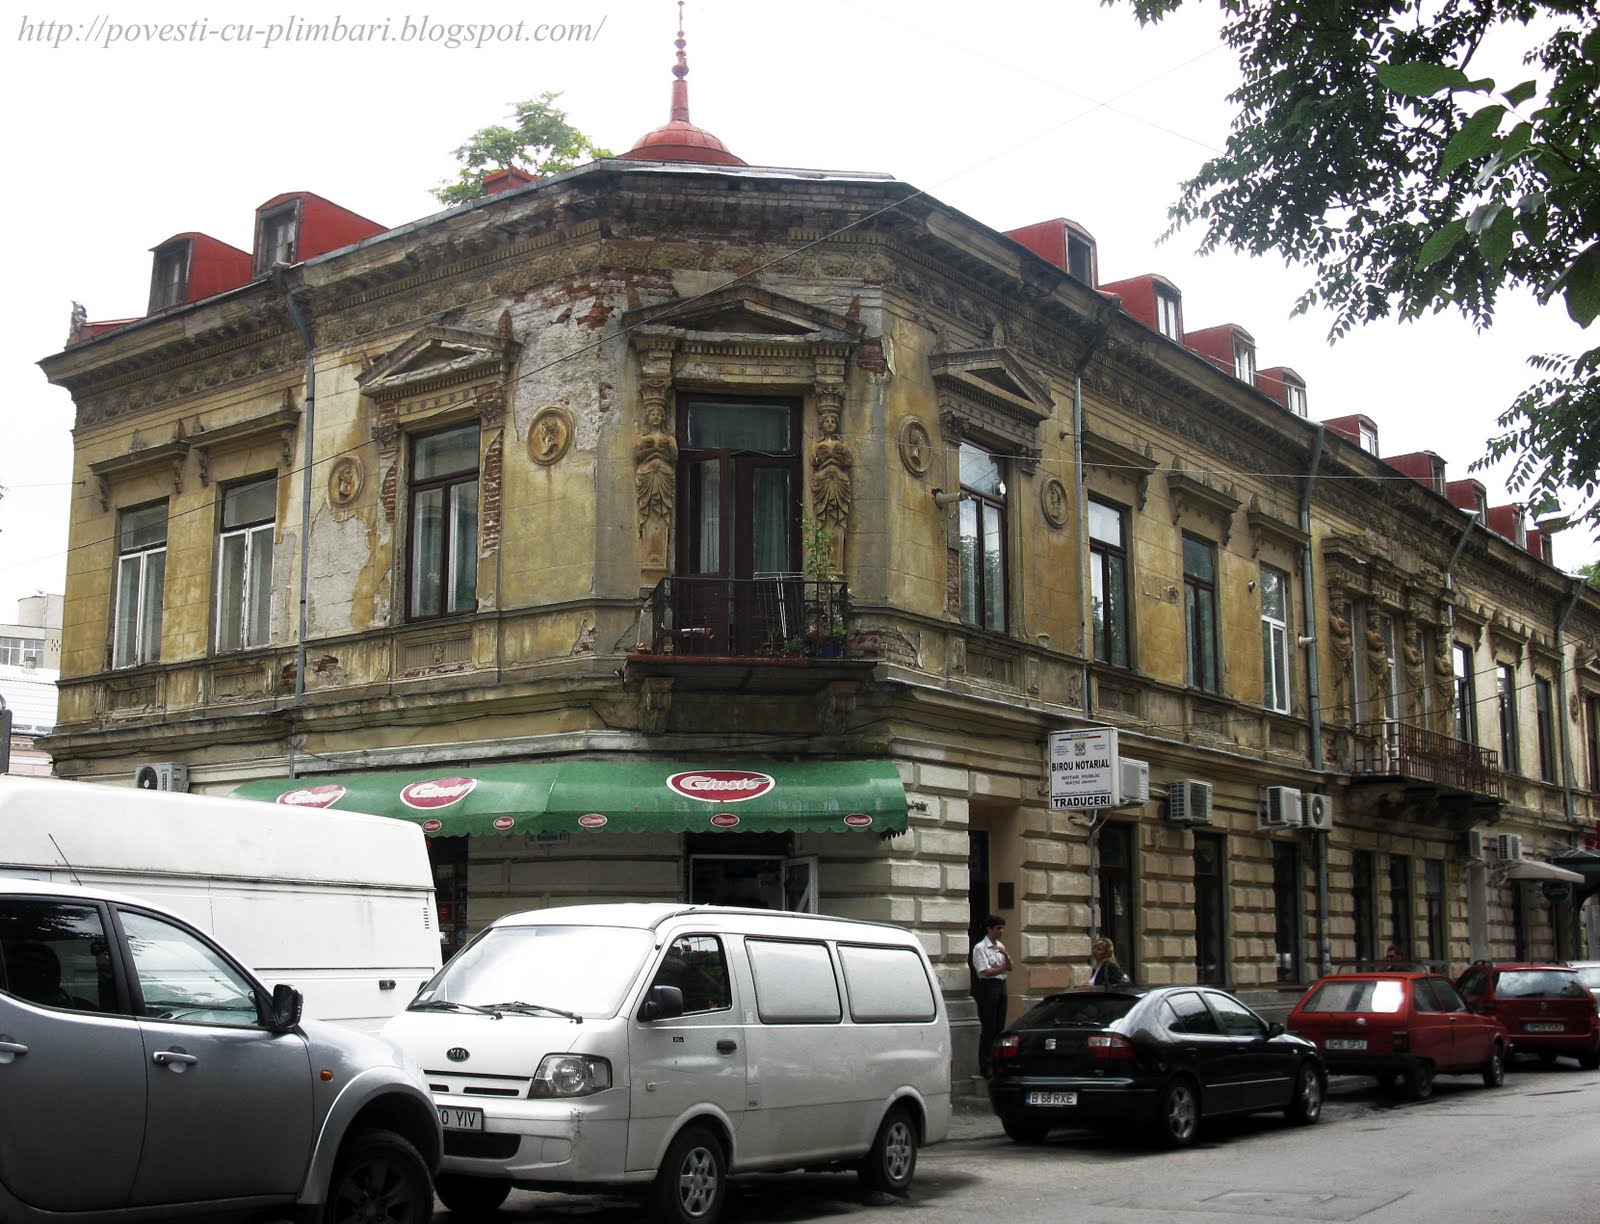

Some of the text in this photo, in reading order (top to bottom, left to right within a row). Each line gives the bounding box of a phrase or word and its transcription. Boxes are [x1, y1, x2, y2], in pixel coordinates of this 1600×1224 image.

[1052, 759, 1110, 772] BIROU NOTARIAL
[680, 776, 760, 790] Giusto
[1053, 795, 1111, 808] TRADUCERI
[451, 1049, 466, 1058] KIA
[1032, 1093, 1039, 1103] B
[1053, 1093, 1073, 1104] RXE
[456, 1111, 476, 1127] YIV
